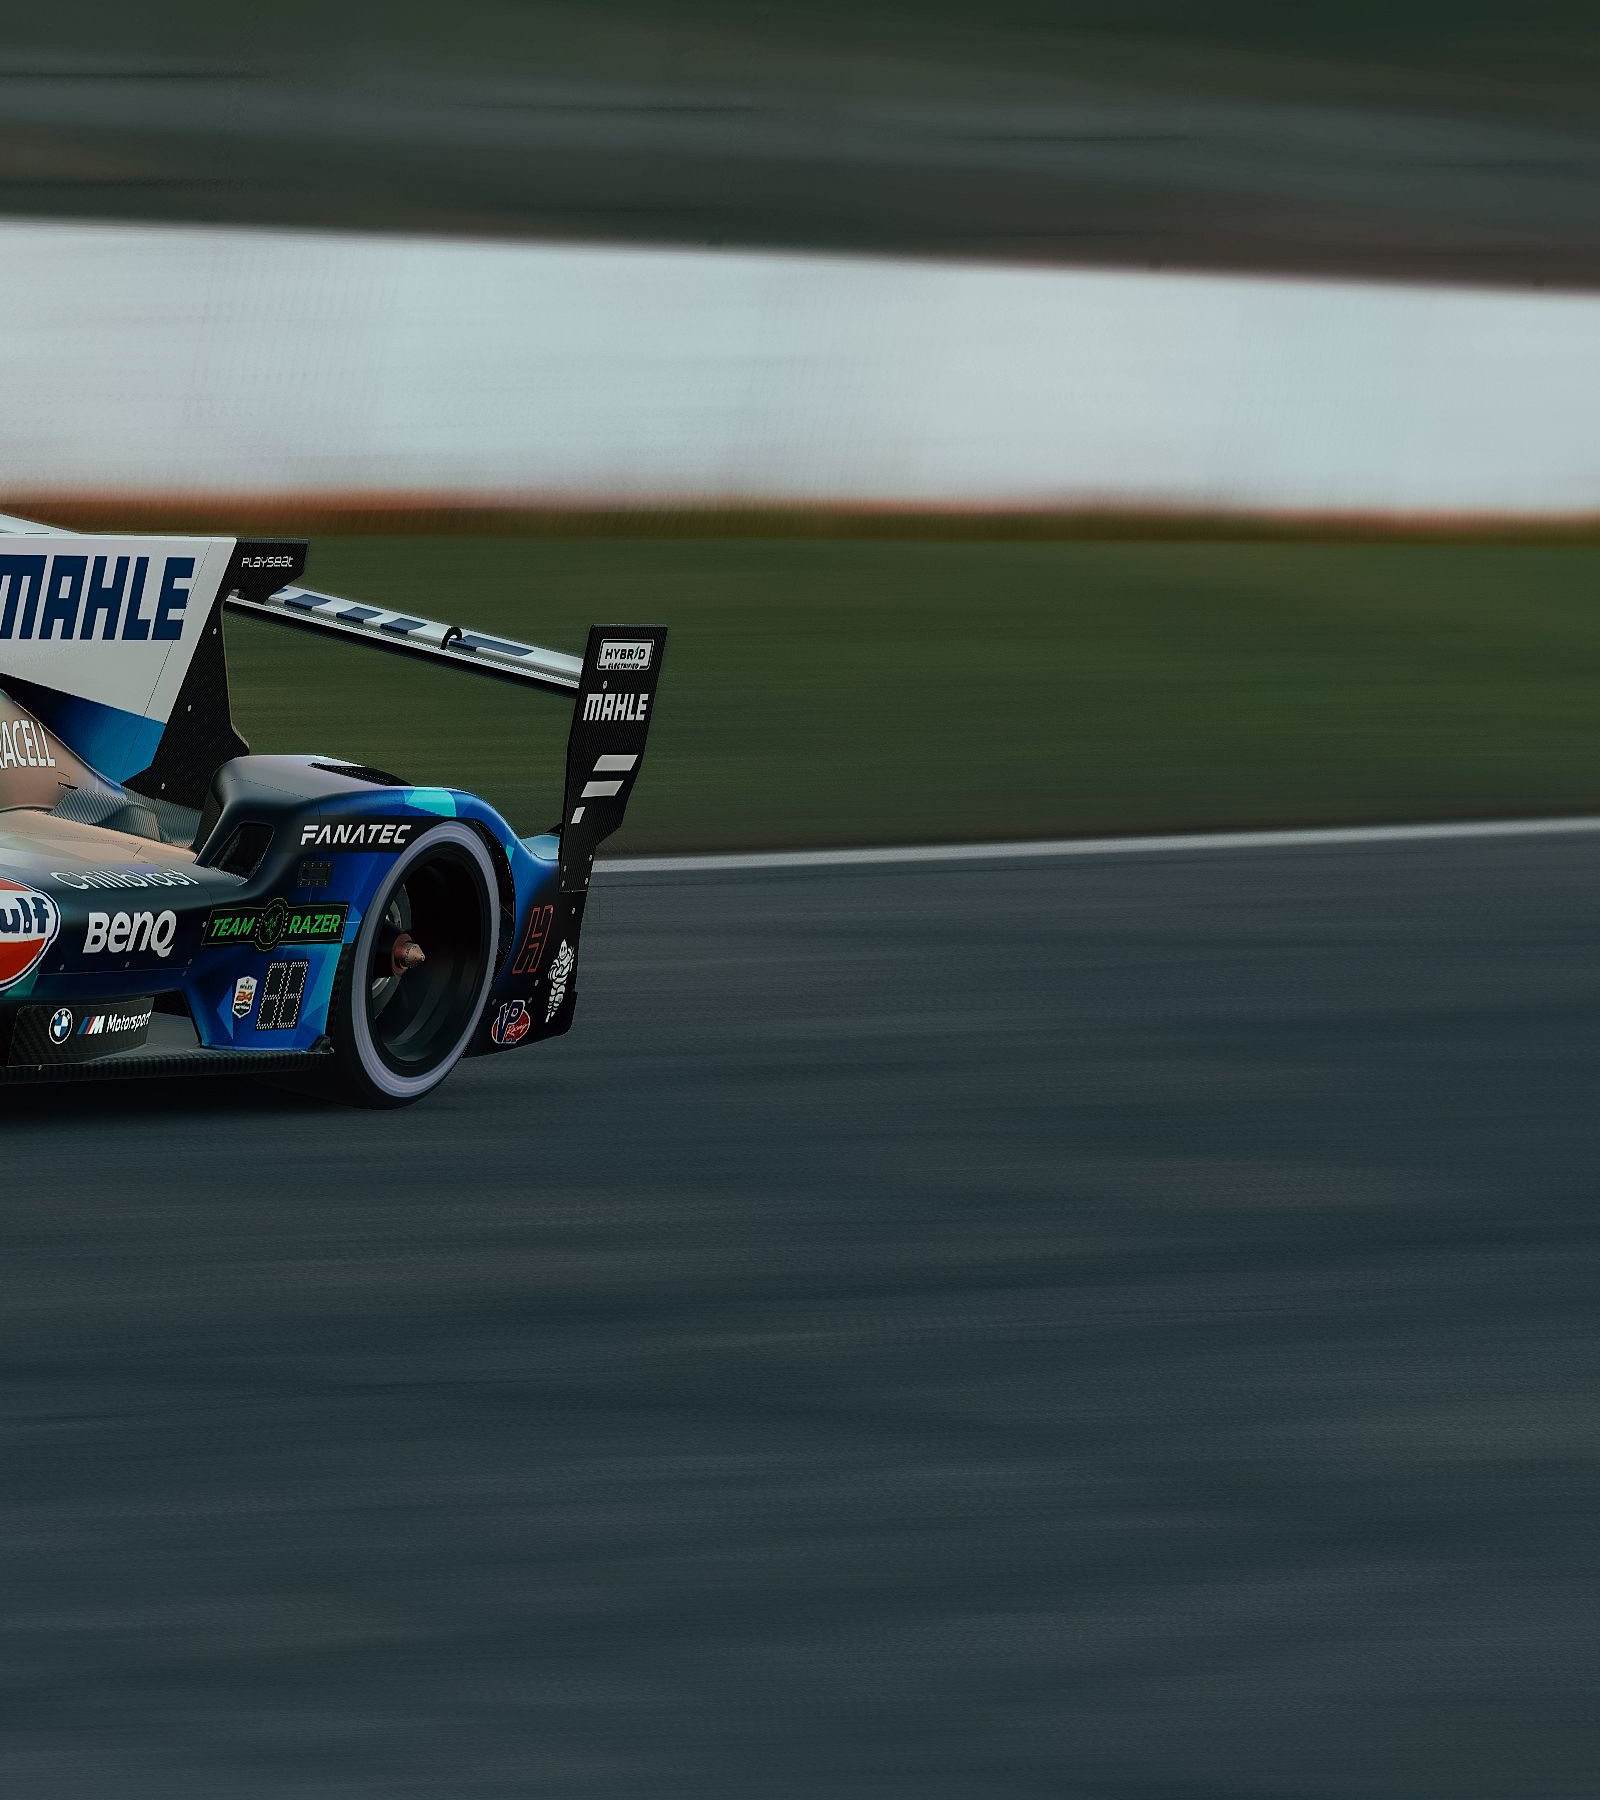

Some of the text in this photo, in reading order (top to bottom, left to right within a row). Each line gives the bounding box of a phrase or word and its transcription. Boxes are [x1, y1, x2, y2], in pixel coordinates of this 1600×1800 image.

[604, 645, 646, 660] HYBRID
[582, 693, 650, 721] MAHLE
[300, 823, 412, 846] FANATEC
[50, 868, 200, 890] Chillblast
[81, 909, 178, 958] BenQ
[210, 913, 342, 937] TEAM RAZER
[106, 1009, 152, 1033] Motorsport
